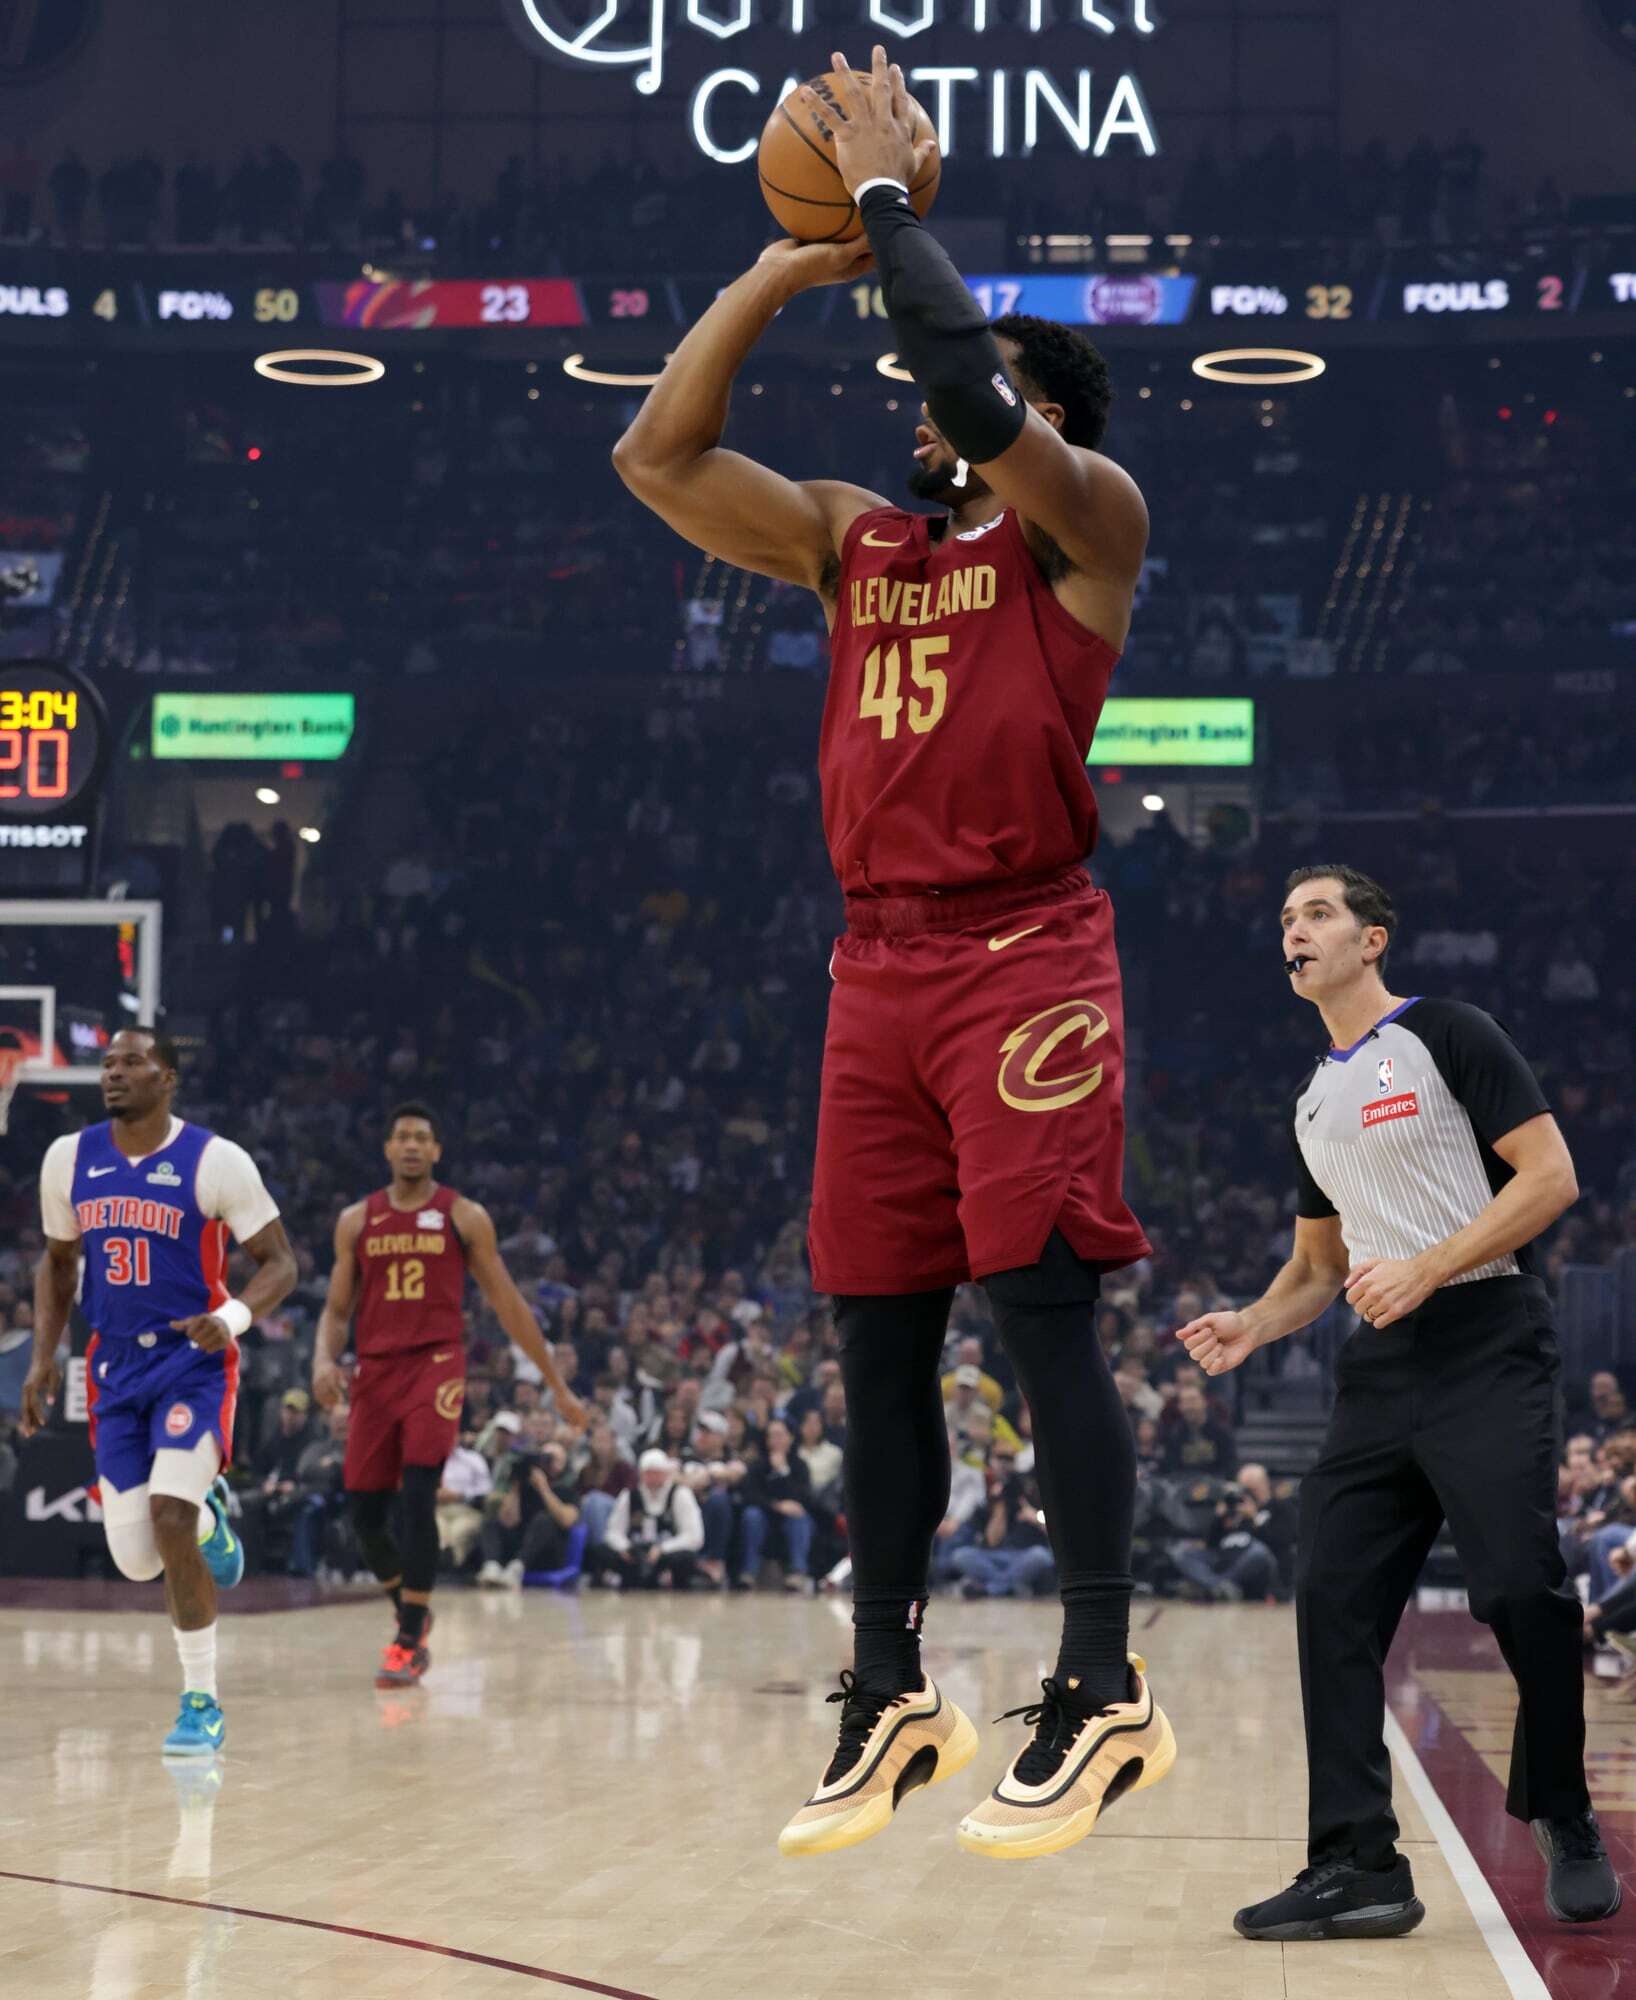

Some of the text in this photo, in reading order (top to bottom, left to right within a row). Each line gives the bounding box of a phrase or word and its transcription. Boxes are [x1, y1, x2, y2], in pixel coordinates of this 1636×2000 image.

[691, 67, 1157, 164] CTINA
[94, 288, 117, 321] 4
[158, 288, 299, 322] FG% 50
[480, 286, 530, 322] 23
[610, 290, 649, 317] 20
[975, 281, 1021, 317] 17
[1211, 285, 1352, 320] FG% 32
[1403, 275, 1564, 313] FOULS 2
[859, 635, 950, 740] 45
[0, 691, 77, 730] 3:04
[189, 717, 347, 741] Huntington Bank
[1095, 716, 1245, 744] untington Bank
[0, 825, 87, 847] TISSOT
[1363, 1099, 1416, 1123] Emirates
[76, 1195, 184, 1240] DETROIT
[103, 1237, 150, 1287] 31
[366, 1232, 446, 1257] CLEVELAND
[384, 1258, 425, 1301] 12
